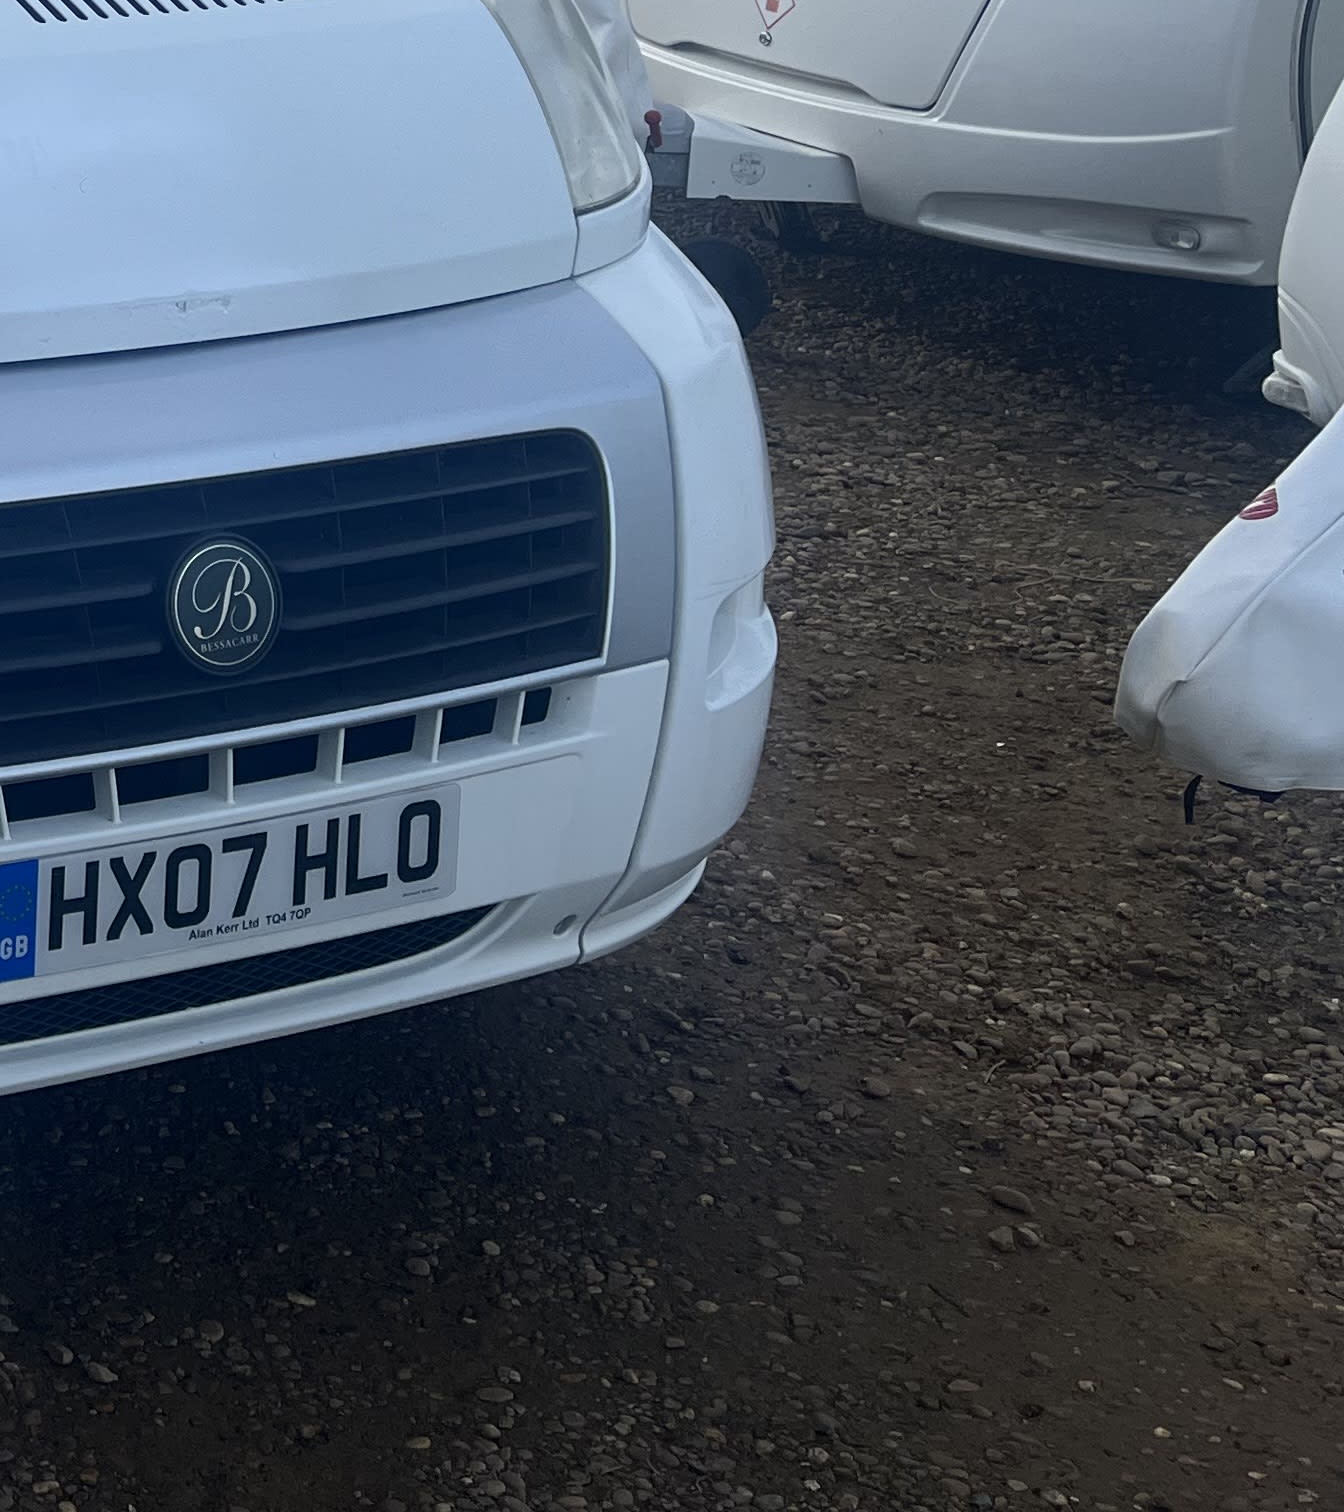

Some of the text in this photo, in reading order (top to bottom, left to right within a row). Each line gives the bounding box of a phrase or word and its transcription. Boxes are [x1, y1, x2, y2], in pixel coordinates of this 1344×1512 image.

[192, 556, 258, 640] B
[200, 633, 260, 654] BESSACARR
[47, 798, 443, 952] HX07 HLO
[188, 907, 312, 941] Alan Kerr Ltd TQ4 7QP
[0, 934, 29, 961] GB
